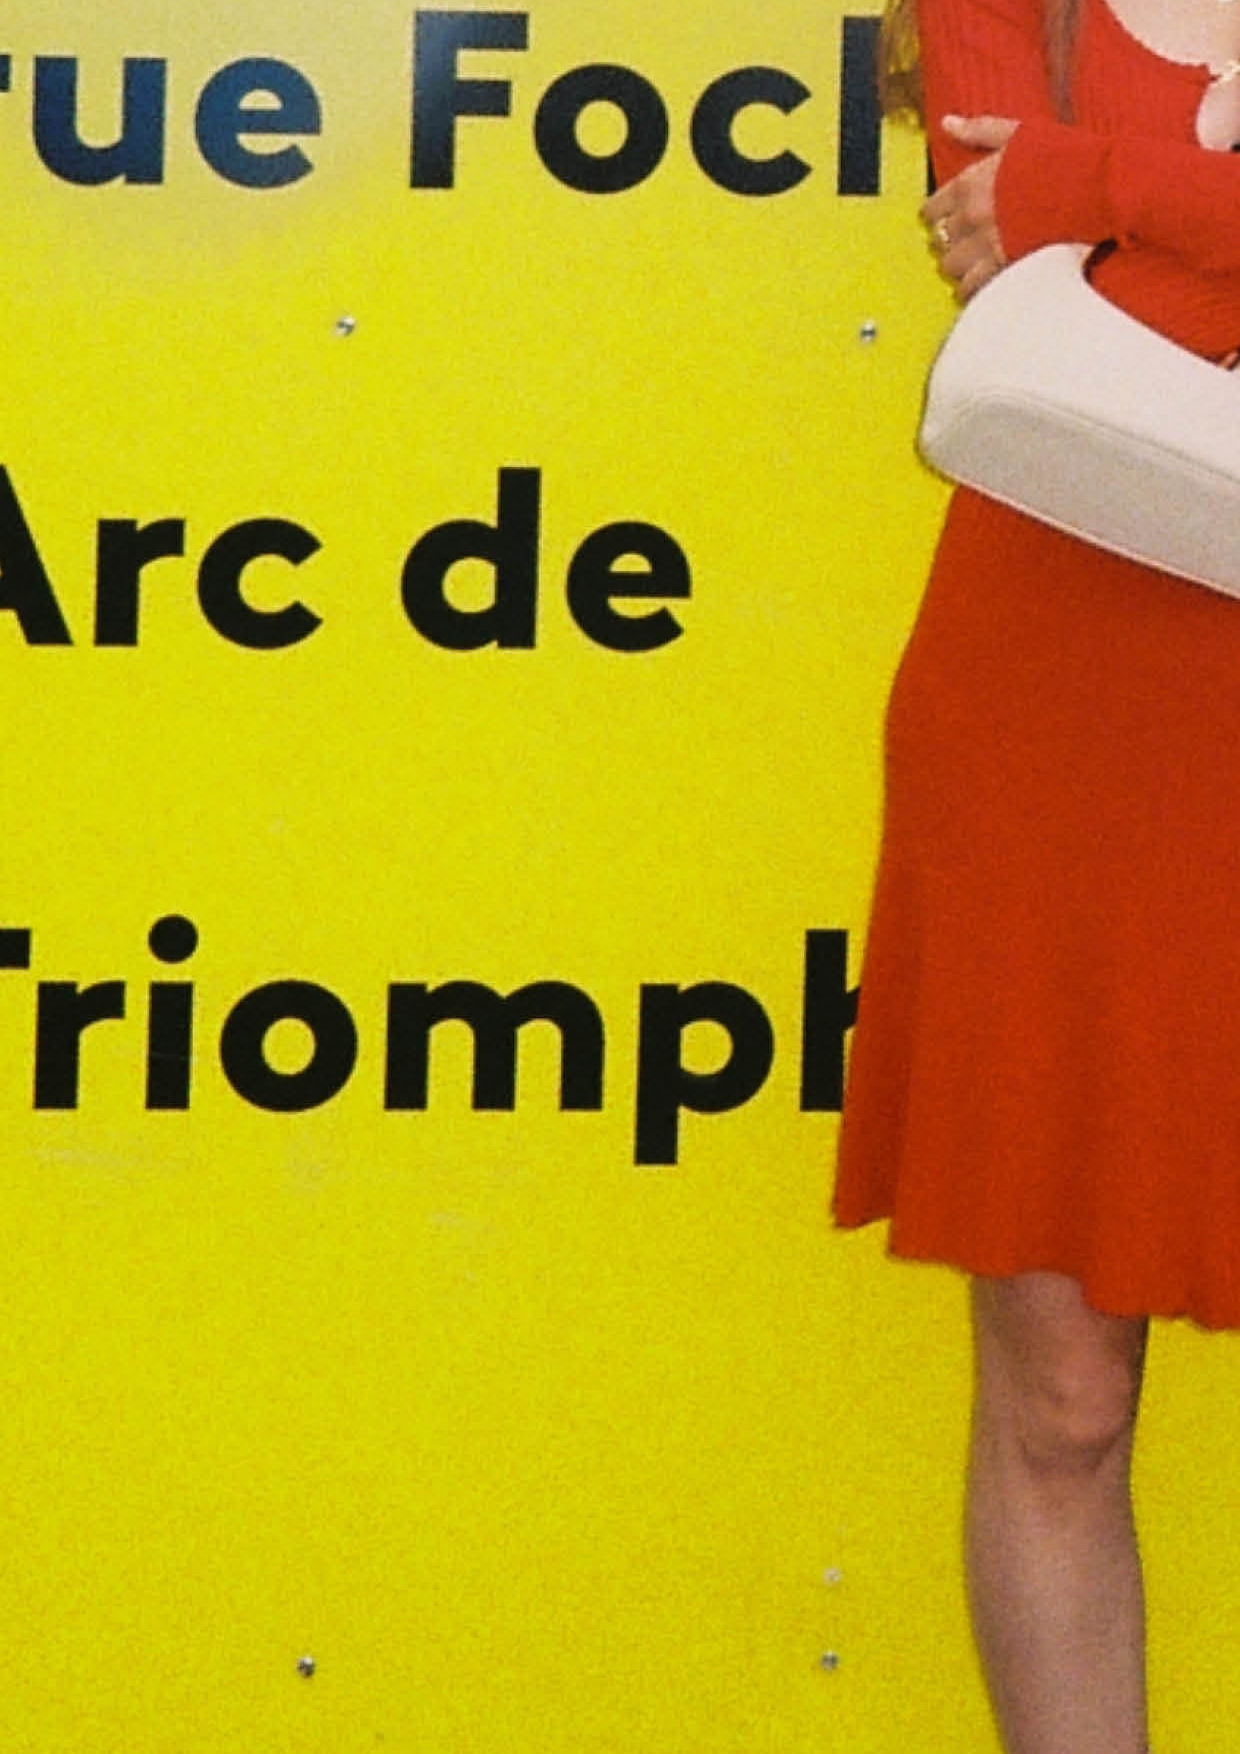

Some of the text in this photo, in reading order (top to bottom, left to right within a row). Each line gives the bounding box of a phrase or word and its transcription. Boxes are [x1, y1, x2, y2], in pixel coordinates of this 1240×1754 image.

[0, 53, 323, 189] ue
[400, 466, 693, 652] de
[0, 913, 862, 1166] riomph
